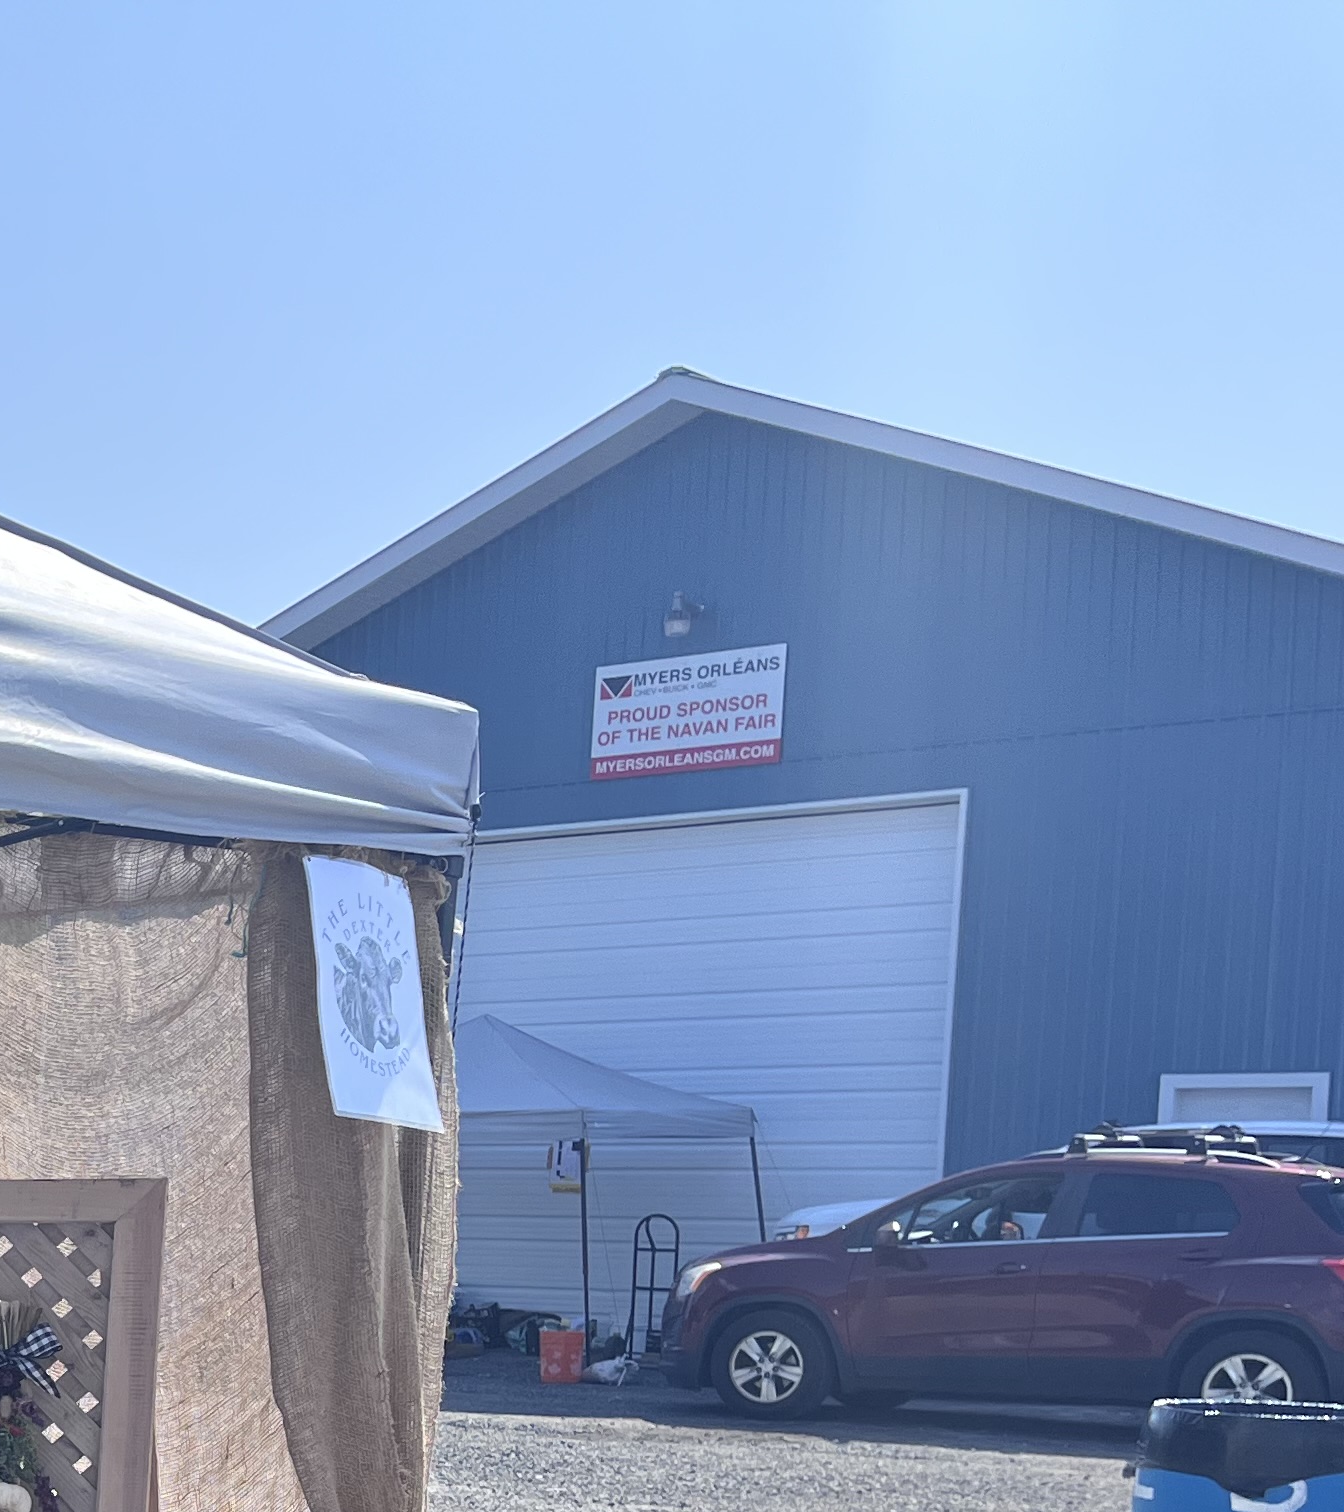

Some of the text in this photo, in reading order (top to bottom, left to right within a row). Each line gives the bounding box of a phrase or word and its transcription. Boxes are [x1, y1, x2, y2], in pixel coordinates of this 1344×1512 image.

[633, 656, 781, 688] MYERS ORLÉANS
[607, 693, 768, 726] PROUD SPONSOR
[597, 713, 777, 746] OF THE NAVAN FAIR
[595, 744, 775, 774] MYERSORLEANSGM.COM
[321, 898, 349, 945] THE
[342, 919, 391, 953] DEXTER
[339, 1027, 411, 1078] HOMESTEAD
